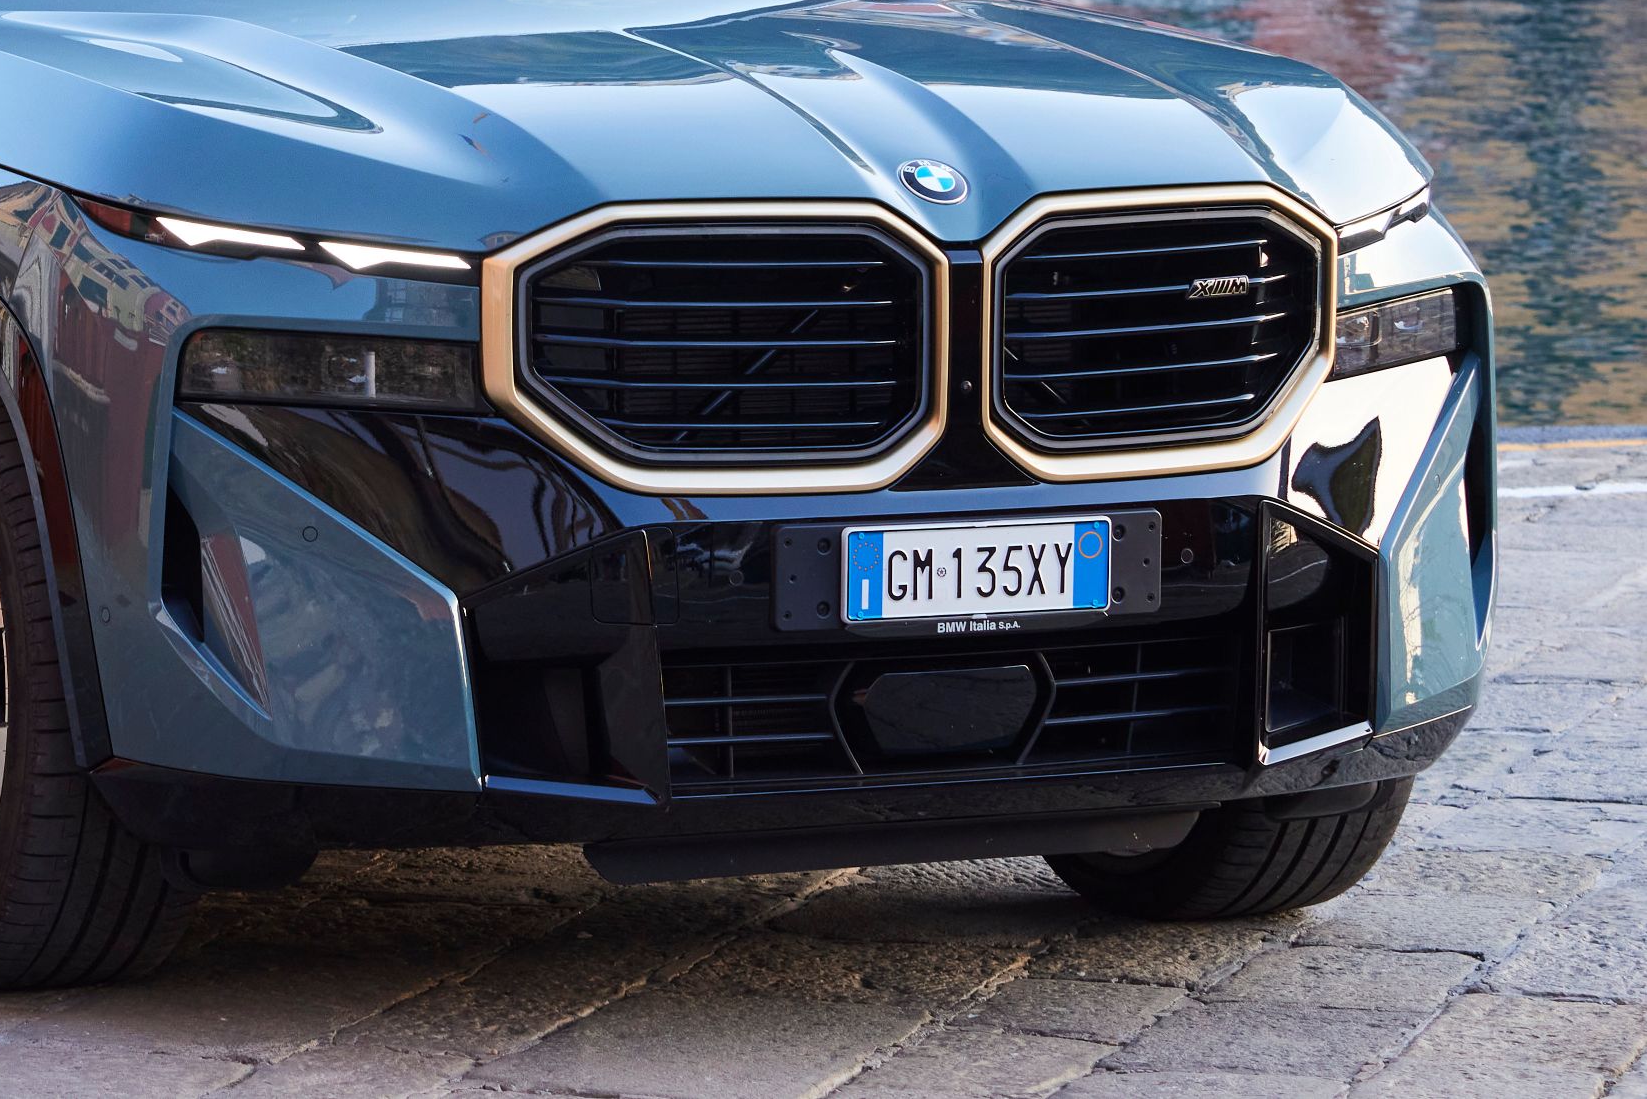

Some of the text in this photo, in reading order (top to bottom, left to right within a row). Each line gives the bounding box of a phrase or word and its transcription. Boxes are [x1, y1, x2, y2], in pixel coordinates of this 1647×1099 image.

[937, 619, 1021, 633] BMW Italia S.p.A.
